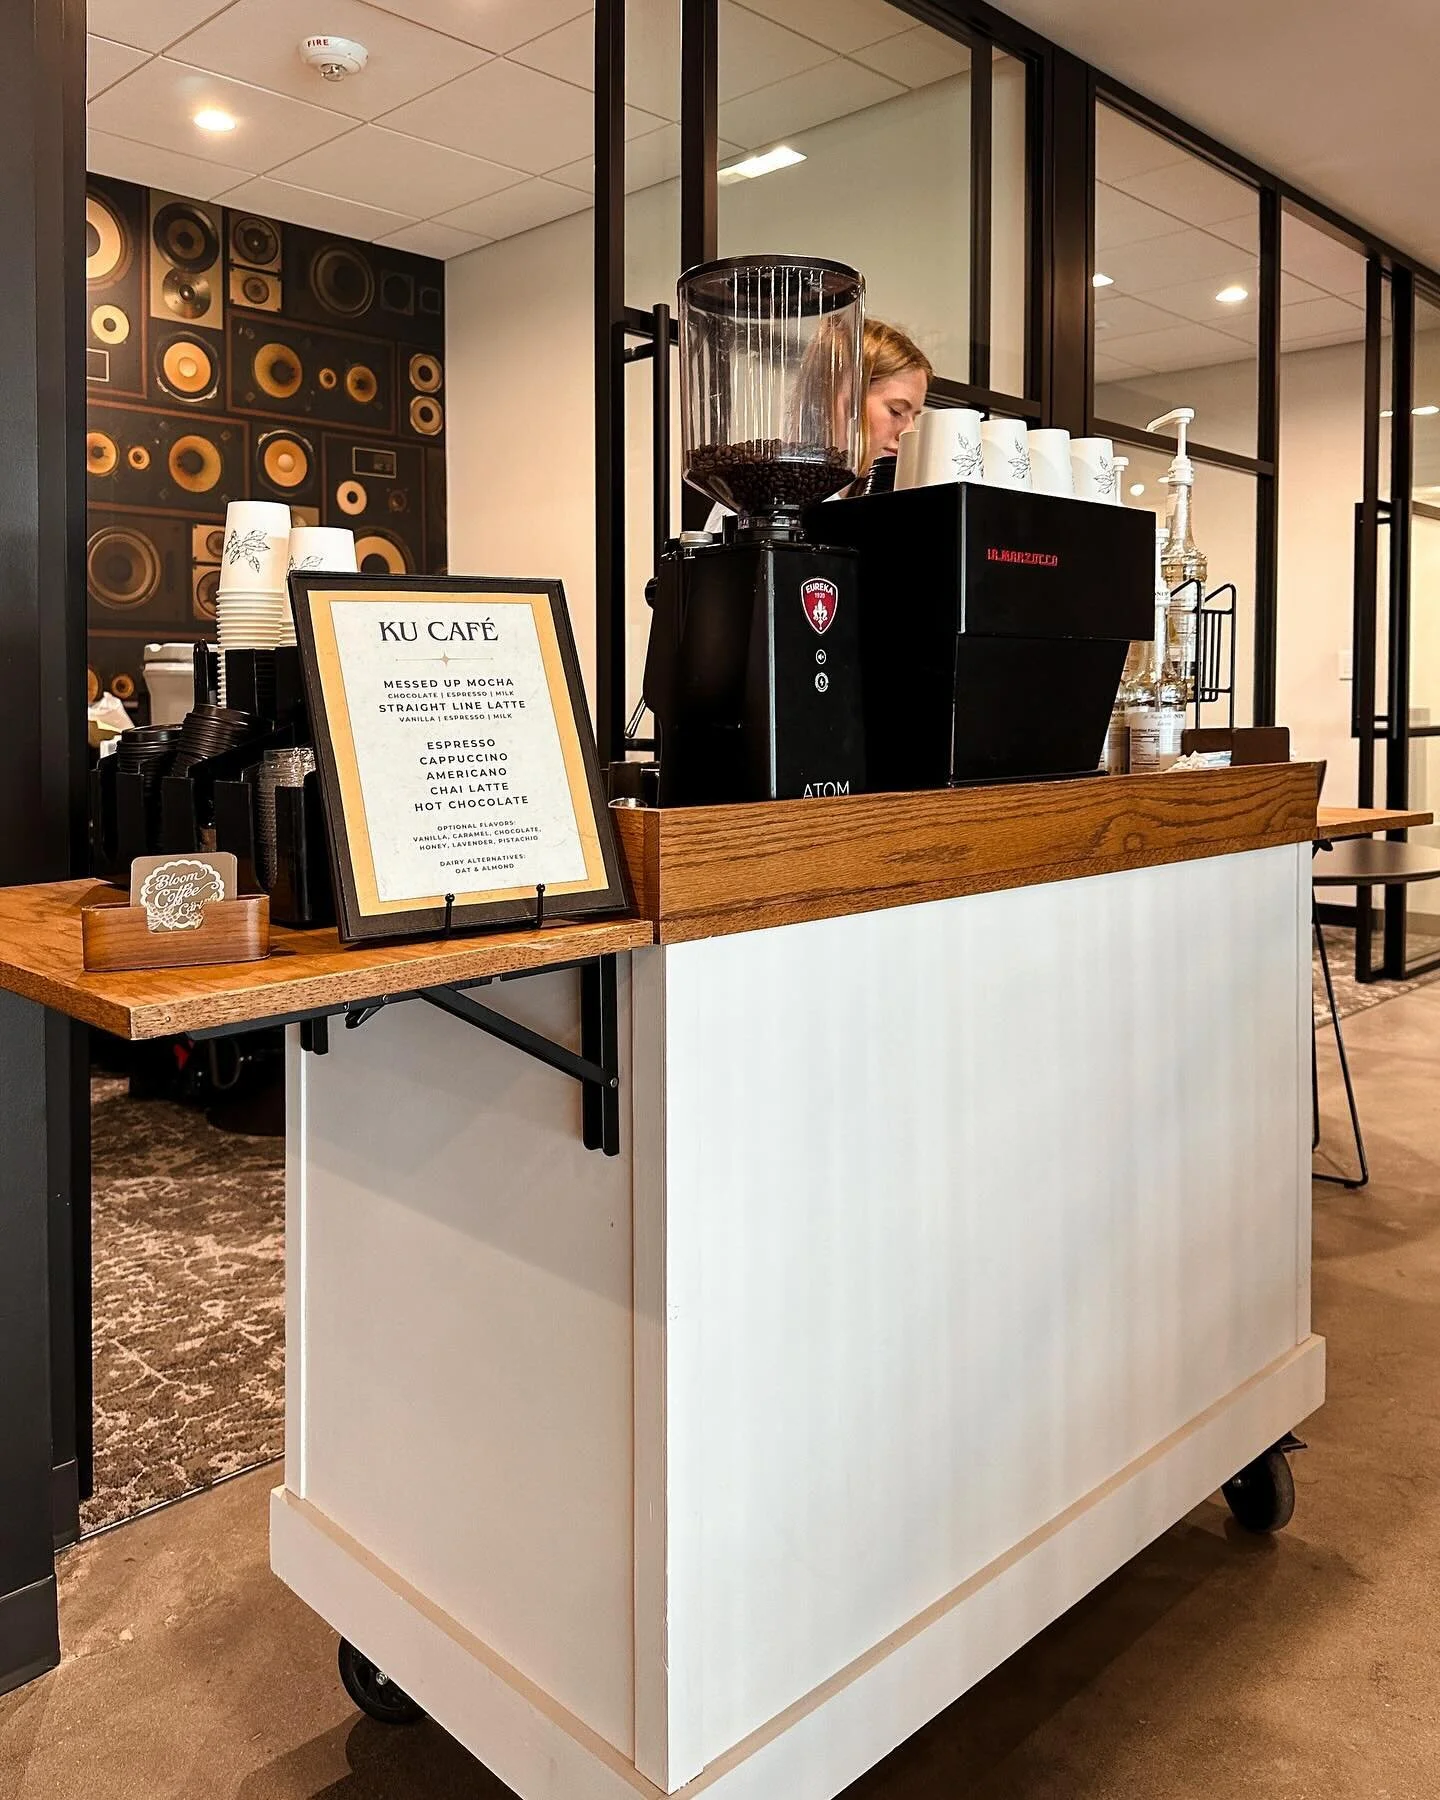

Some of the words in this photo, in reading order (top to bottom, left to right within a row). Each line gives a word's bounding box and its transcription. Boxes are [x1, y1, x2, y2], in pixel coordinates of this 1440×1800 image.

[307, 39, 329, 48] FIRE
[805, 582, 834, 596] EUREKA
[378, 620, 418, 642] KU
[428, 617, 499, 642] CAFÉ
[383, 679, 438, 689] MESSED
[444, 679, 461, 688] UP
[467, 678, 514, 687] MOCHA
[379, 703, 446, 713] STRAIGHT
[452, 701, 482, 711] LINE
[487, 700, 526, 710] LATTE
[427, 738, 496, 750] ESPRESSO
[419, 753, 508, 766] CAPPUCCINO
[426, 767, 507, 781] AMERICANO
[430, 784, 464, 796] CHAI
[469, 782, 510, 794] LATTE
[803, 780, 850, 800] ATOM
[414, 800, 443, 812] HOT
[448, 795, 529, 810] CHOCOLATE
[437, 823, 477, 832] OPTIONAL
[479, 820, 516, 828] FLAVORS:
[413, 834, 450, 843] VANILLA,
[452, 831, 492, 839] CARAMEL,
[494, 826, 542, 836] CHOCOLATE,
[419, 843, 450, 851] HONEY,
[452, 839, 496, 848] LAVENDER,
[498, 835, 539, 844] PISTACHIO
[439, 859, 464, 867] DAIRY
[467, 854, 526, 864] ALTERNATIVES:
[481, 863, 515, 871] ALMOND
[146, 867, 208, 894] Bloom
[154, 881, 219, 909] Coffee
